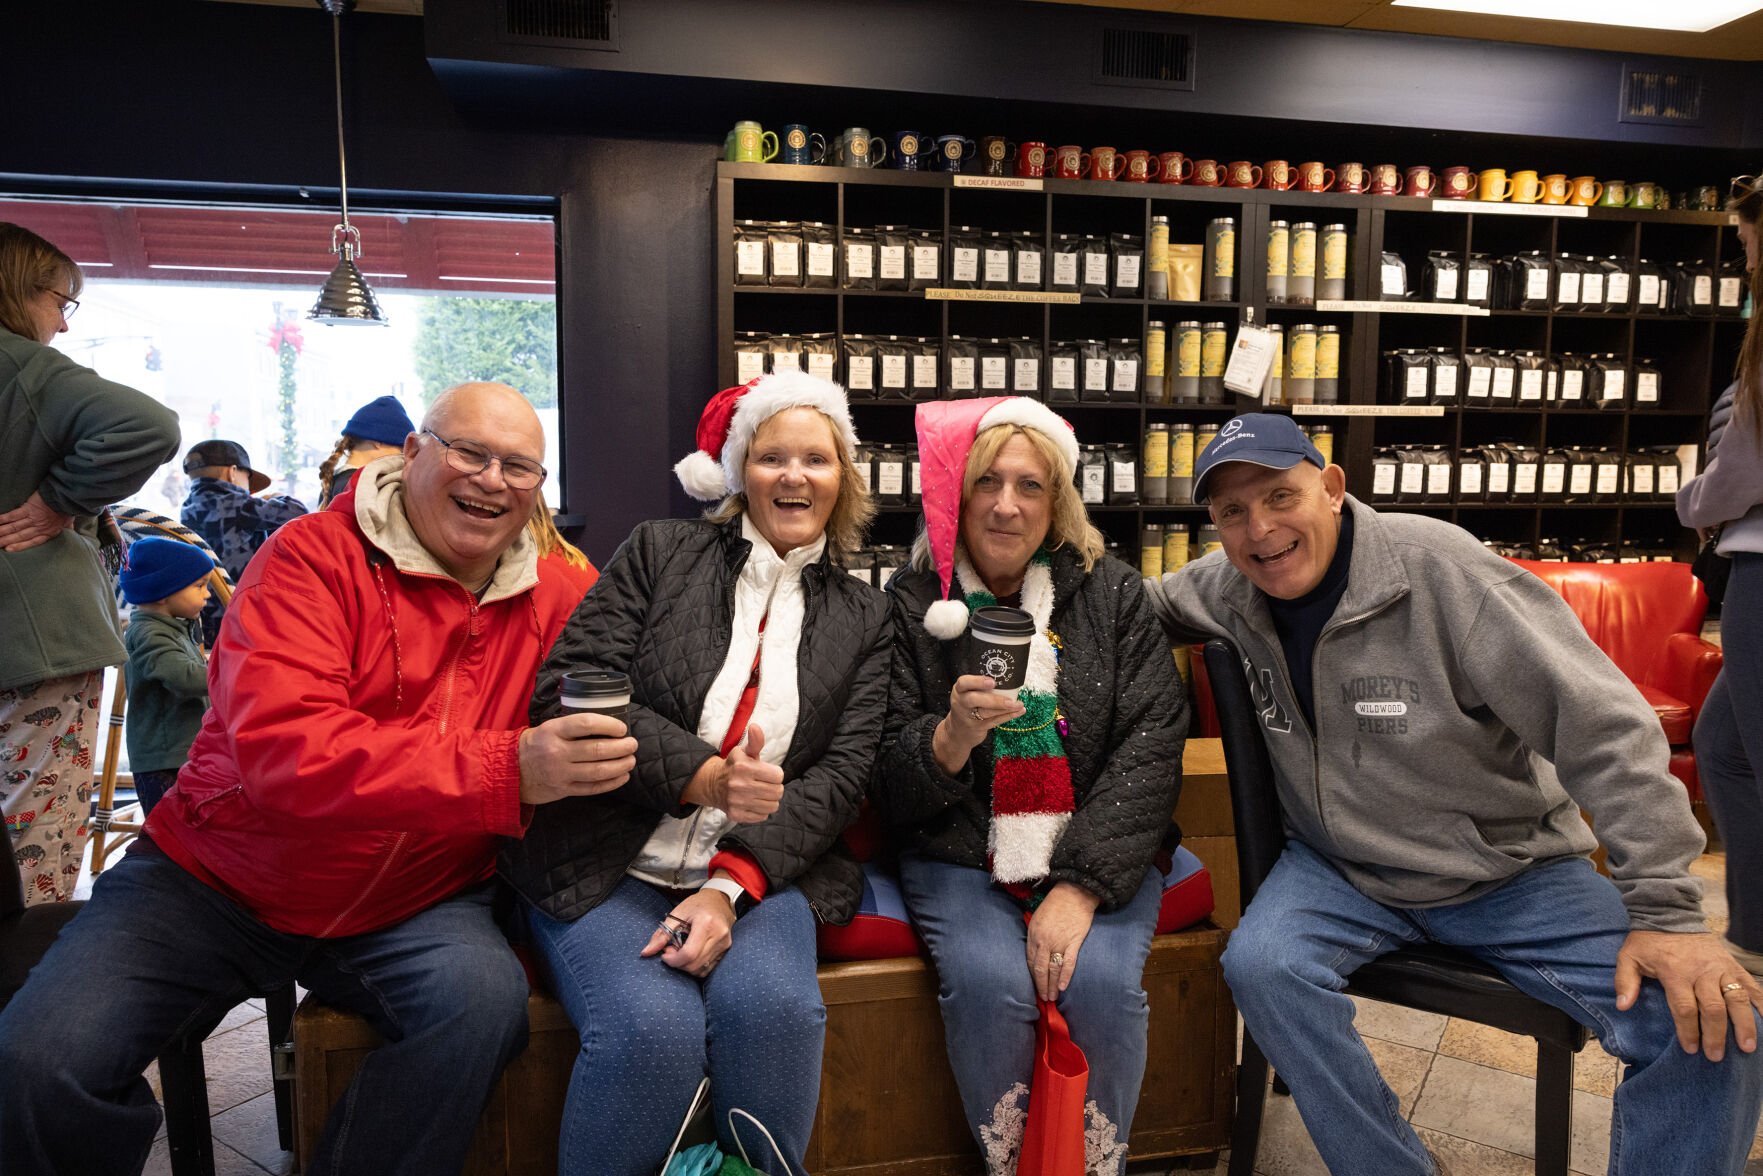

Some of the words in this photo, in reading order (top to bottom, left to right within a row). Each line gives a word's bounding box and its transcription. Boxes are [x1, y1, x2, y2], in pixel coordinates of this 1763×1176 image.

[926, 290, 950, 299] PLEASE
[981, 649, 1002, 659] OCEAN
[1004, 651, 1015, 663] CITY
[1341, 676, 1420, 704] MOREY'S
[1359, 704, 1402, 714] WILDWOOD
[1357, 717, 1409, 735] PIERS
